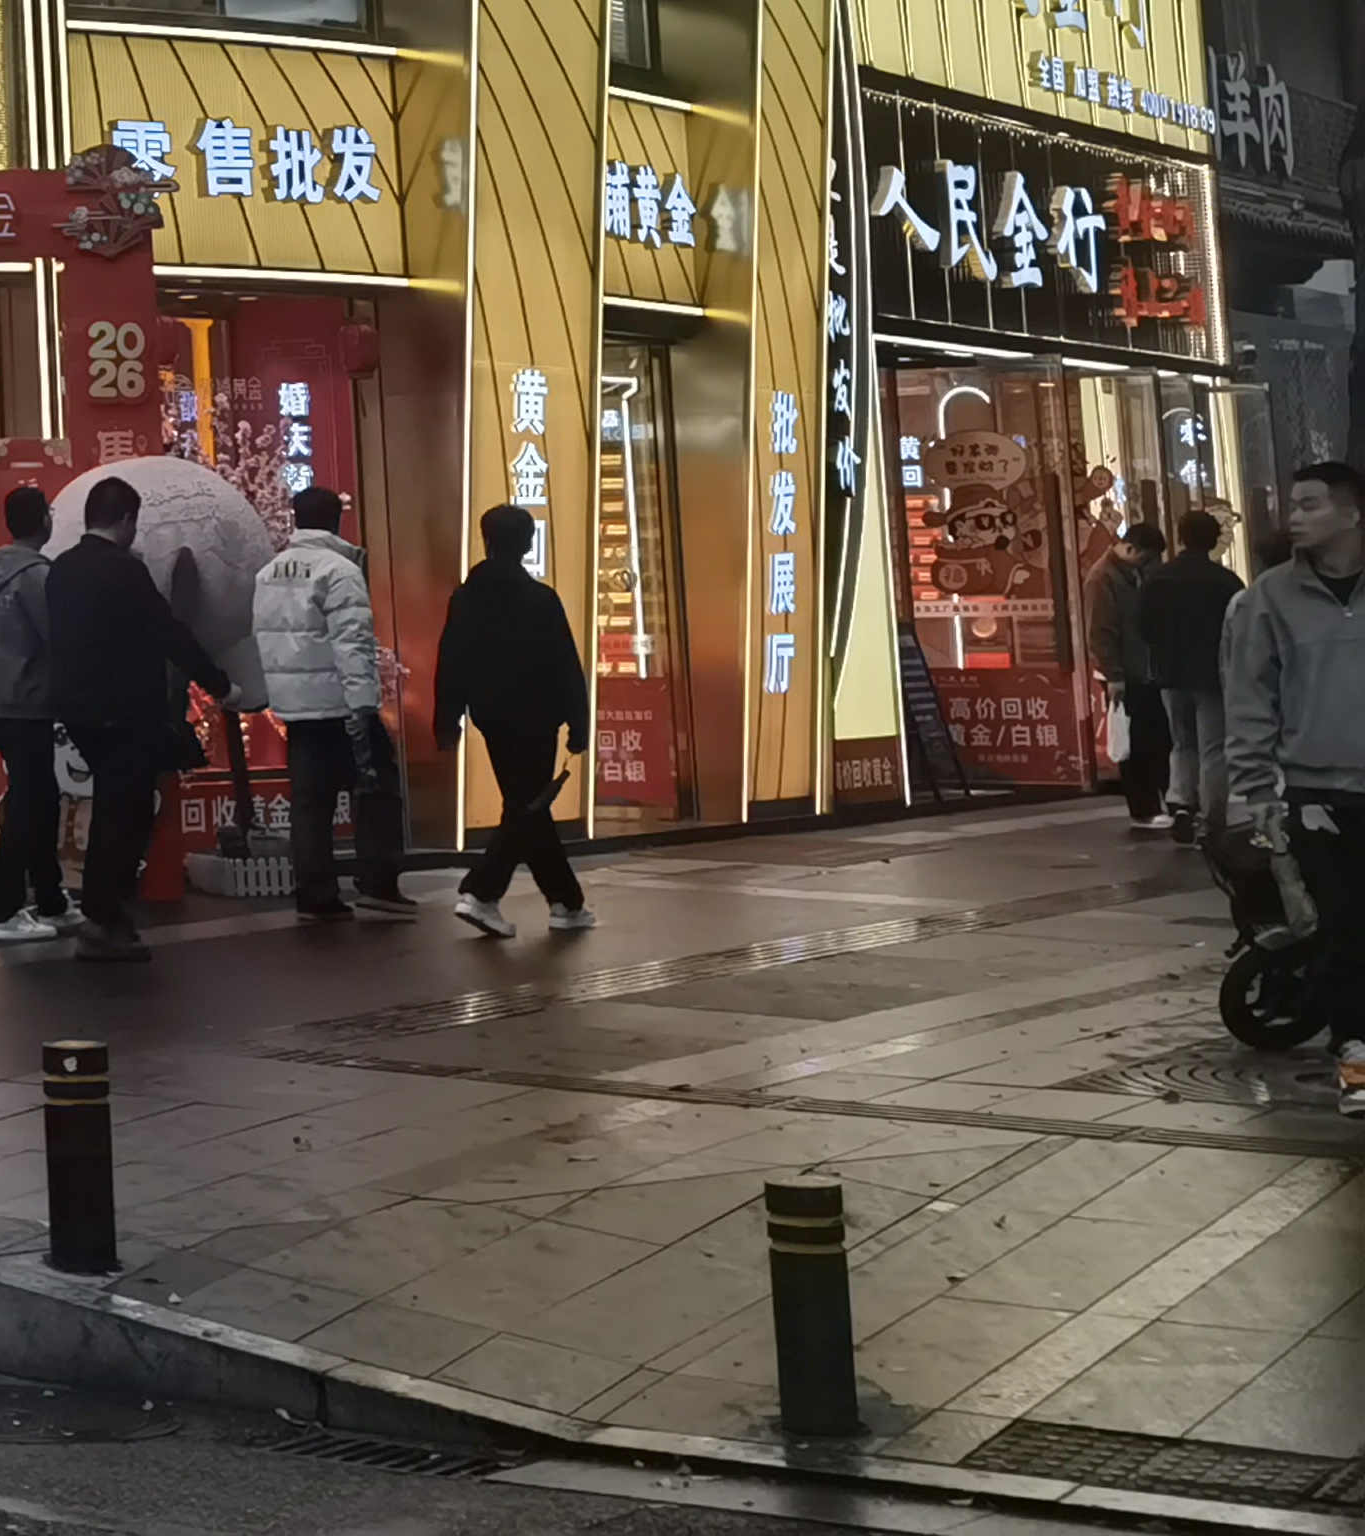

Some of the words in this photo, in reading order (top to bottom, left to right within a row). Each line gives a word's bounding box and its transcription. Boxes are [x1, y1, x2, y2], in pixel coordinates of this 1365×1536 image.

[1038, 52, 1065, 92] 全国
[1074, 66, 1100, 102] 加盟
[1107, 73, 1135, 113] 热线
[1209, 47, 1294, 177] 羊肉
[873, 159, 1107, 293] 人民金行
[87, 321, 146, 360] 20
[88, 359, 146, 398] 26
[764, 391, 799, 695] 批发展厅
[948, 696, 1050, 721] 高价回收
